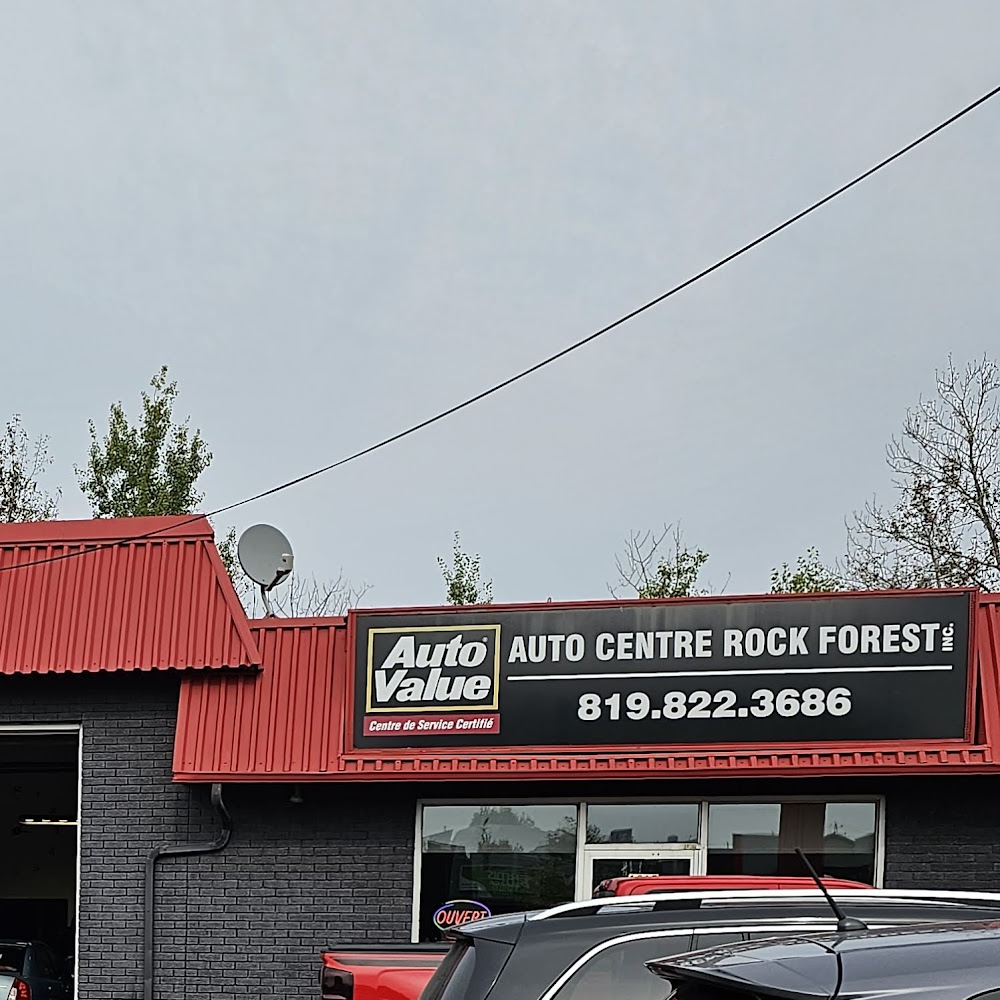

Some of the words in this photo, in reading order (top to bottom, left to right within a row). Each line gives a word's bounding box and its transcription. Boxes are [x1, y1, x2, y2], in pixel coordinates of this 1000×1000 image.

[380, 634, 488, 669] Auto
[507, 633, 585, 663] AUTO
[595, 629, 713, 661] CENTRE
[723, 626, 809, 657] ROCK
[818, 623, 941, 655] FOREST
[941, 622, 954, 652] INC.
[374, 667, 492, 703] Value
[577, 687, 852, 721] 819.822.3686
[368, 720, 401, 732] Centre
[402, 719, 416, 731] de
[416, 718, 454, 731] Service
[455, 717, 495, 730] Certifié
[436, 909, 487, 926] OUVERT
